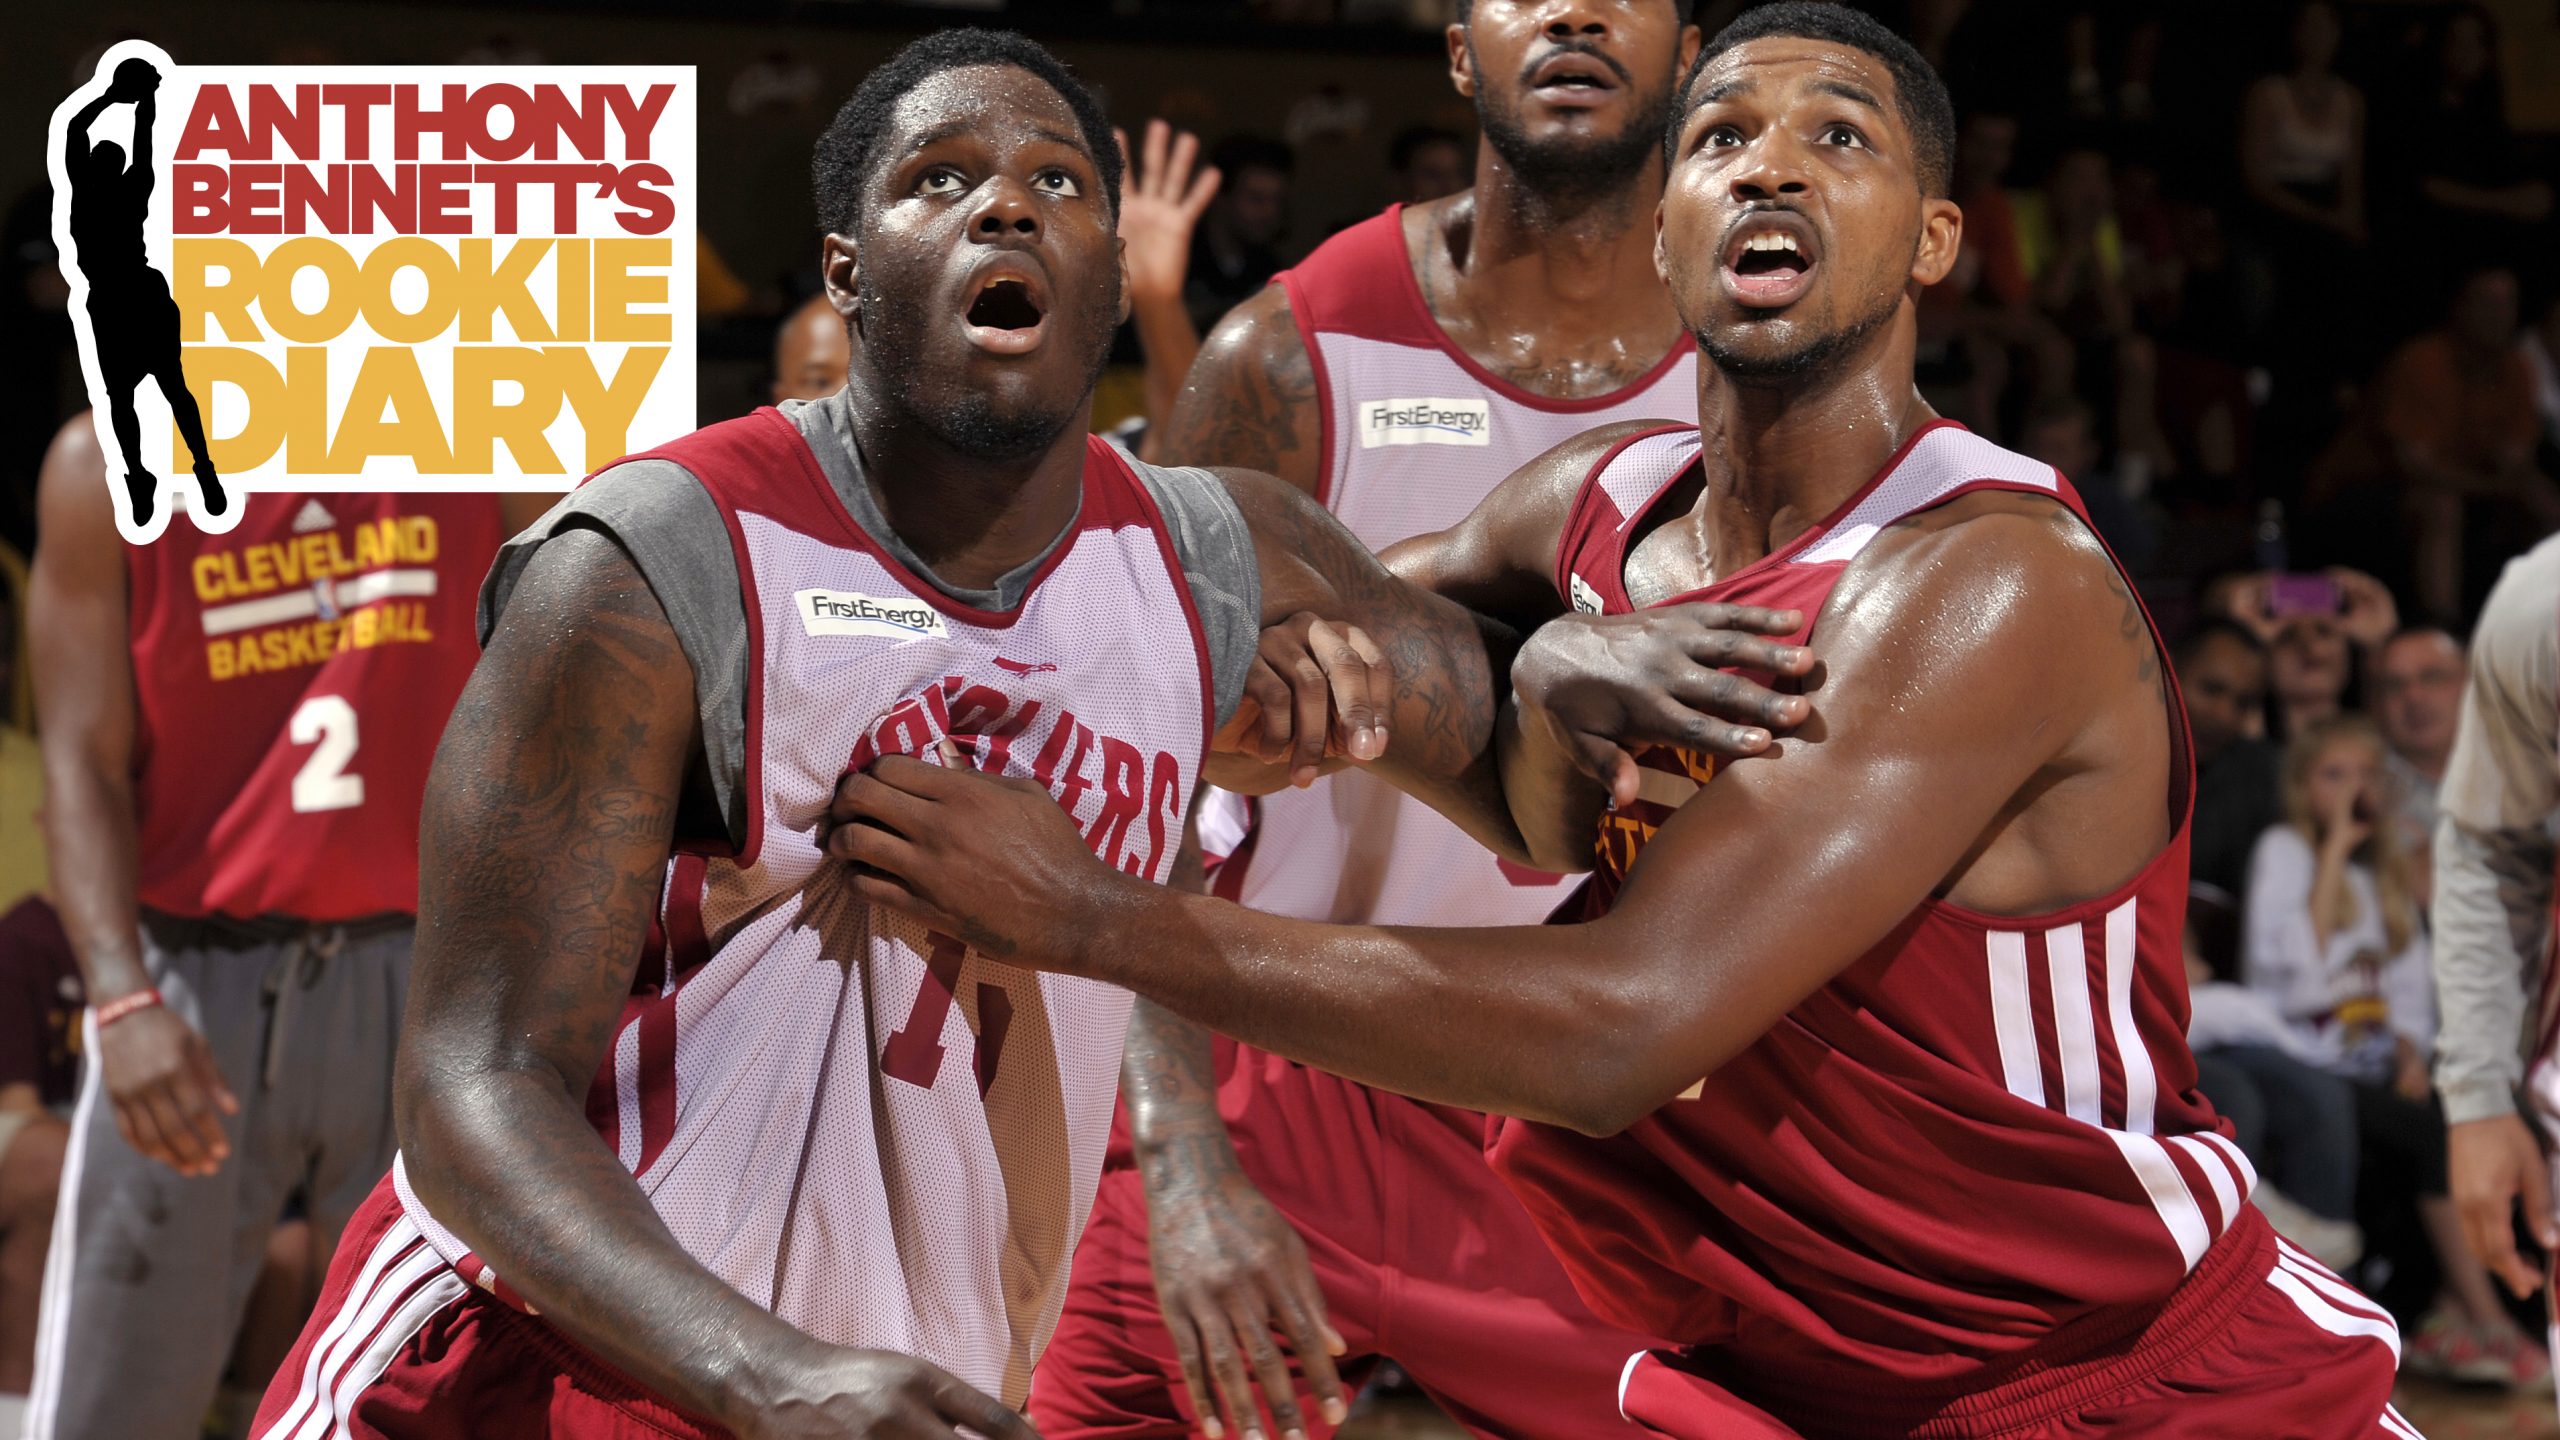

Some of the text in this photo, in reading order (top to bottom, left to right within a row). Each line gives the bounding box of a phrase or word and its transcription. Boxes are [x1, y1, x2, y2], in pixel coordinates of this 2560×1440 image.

[192, 516, 438, 602] CLEVELAND
[207, 603, 434, 681] BASKETBALL
[290, 695, 364, 813] 2
